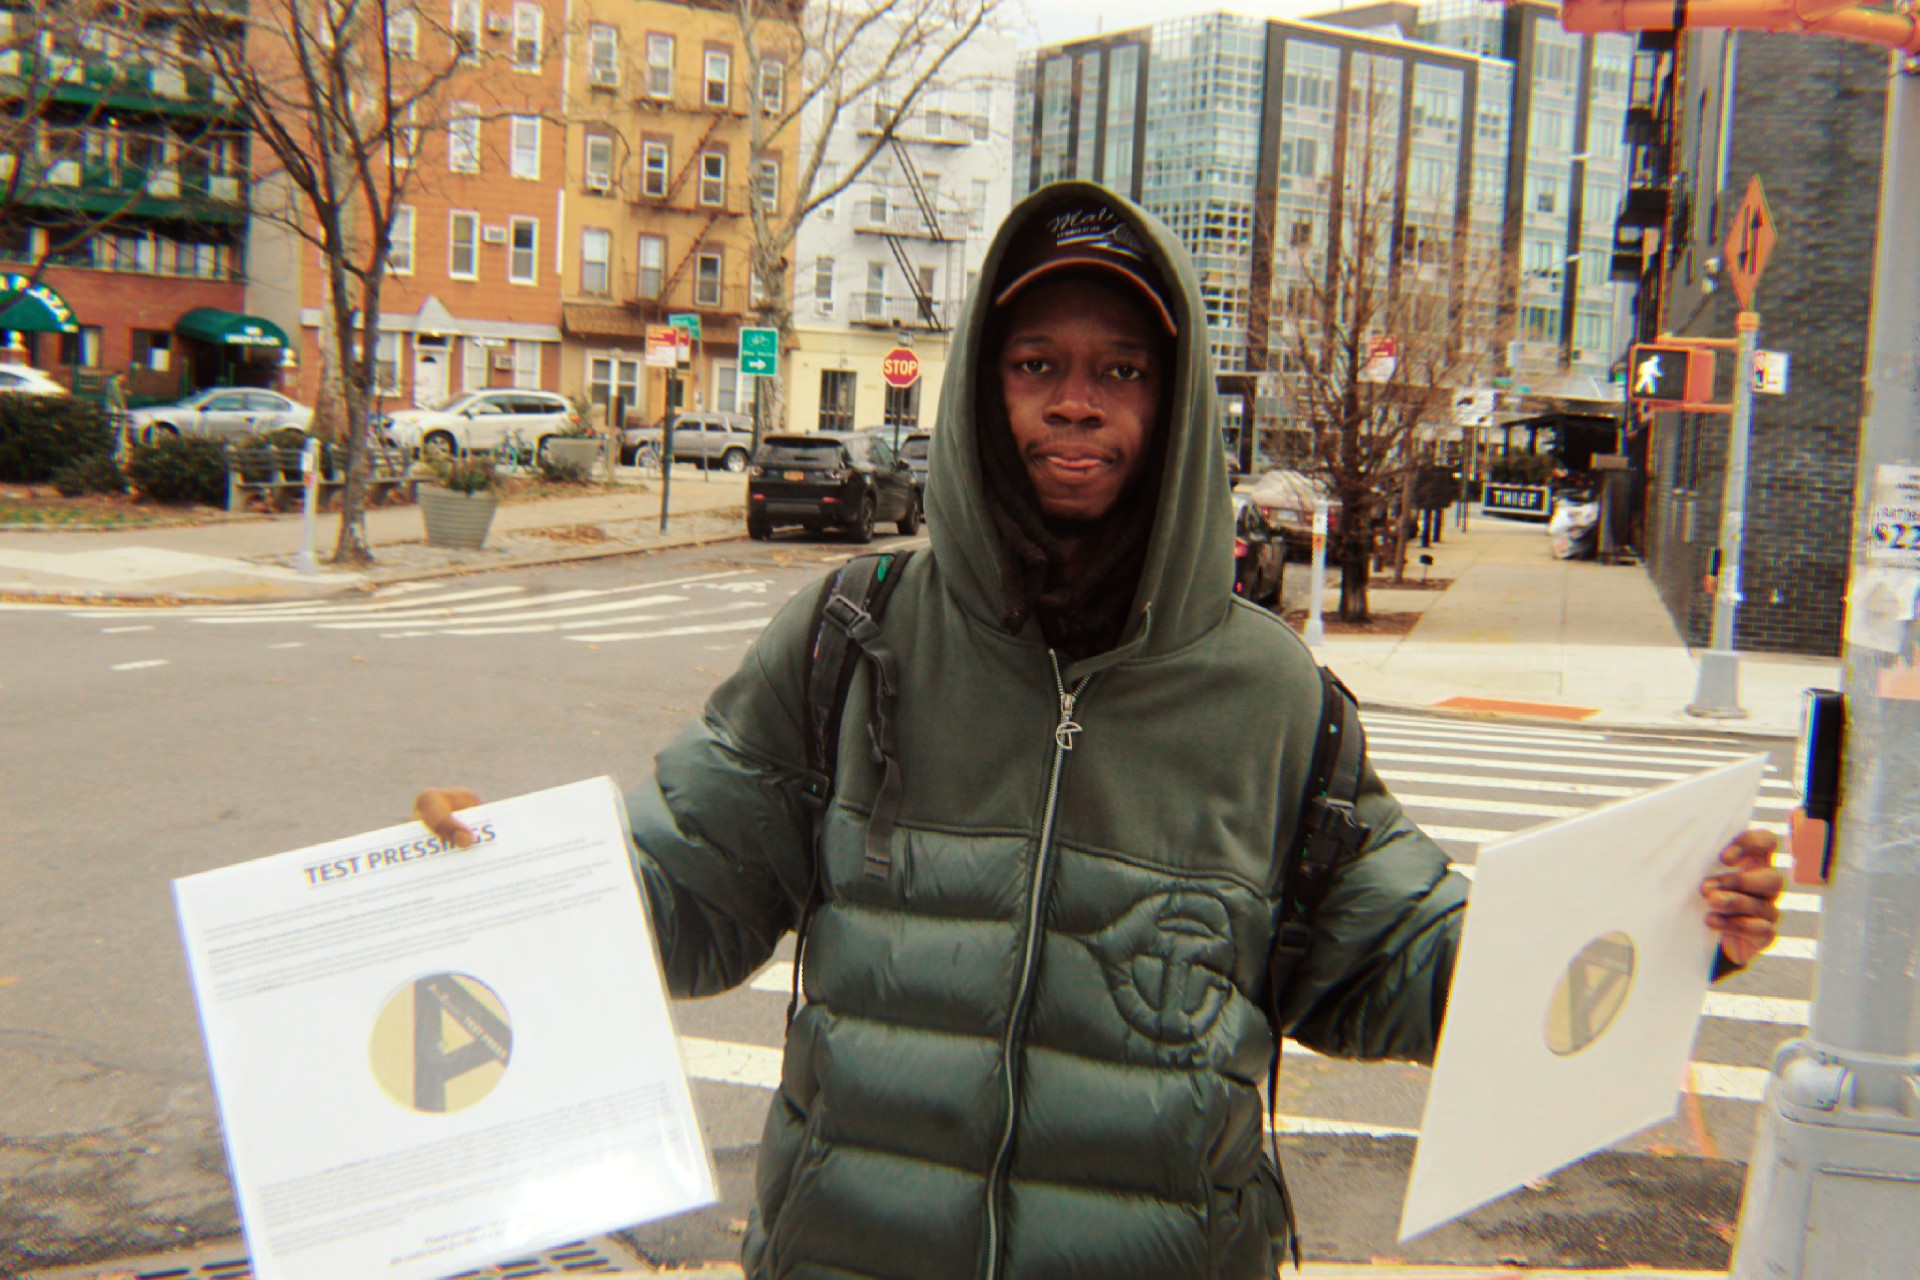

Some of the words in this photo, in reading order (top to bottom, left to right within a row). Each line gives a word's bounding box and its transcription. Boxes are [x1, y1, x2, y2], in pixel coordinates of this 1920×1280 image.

[884, 359, 918, 376] STOP
[1493, 489, 1538, 508] THIEF
[304, 857, 361, 885] TEST
